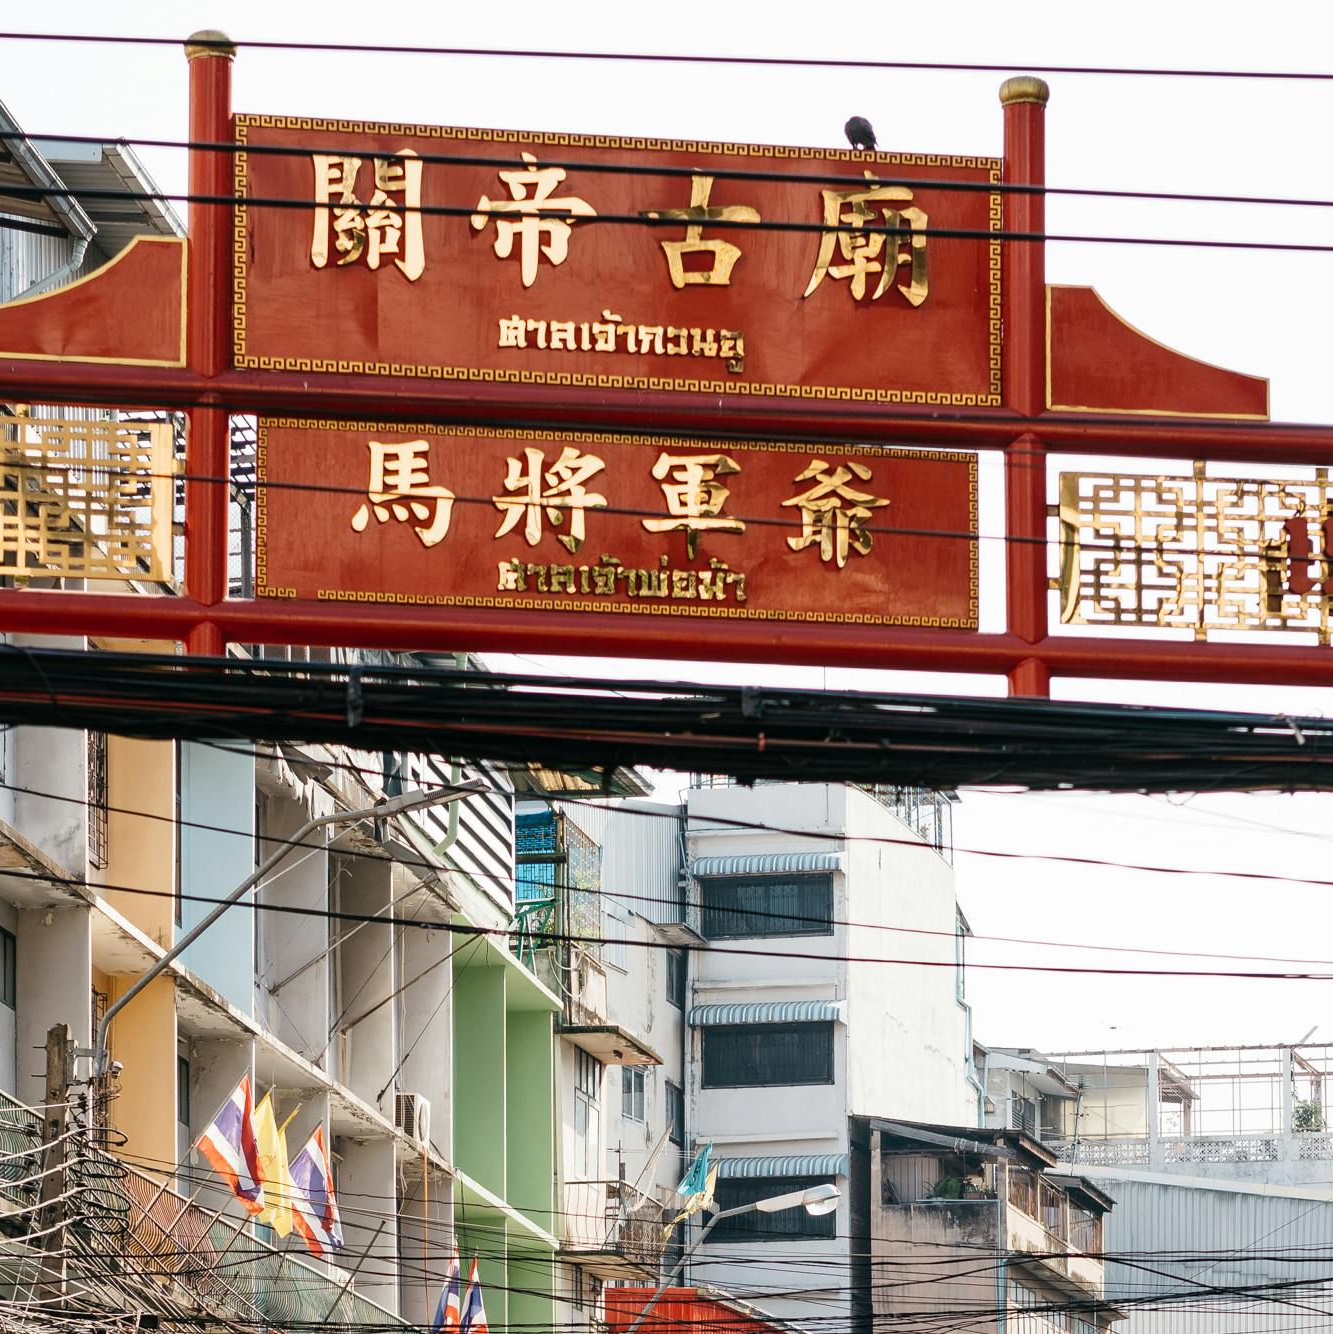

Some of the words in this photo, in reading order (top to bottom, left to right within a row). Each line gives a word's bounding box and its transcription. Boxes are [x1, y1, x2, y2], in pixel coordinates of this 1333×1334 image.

[309, 147, 931, 309] 關帝古廟
[498, 308, 746, 375] ศาลเจ้ากวนอู
[350, 438, 891, 570] 馬將軍爺
[498, 552, 747, 602] ศาลเจ้าพ่อม้า
